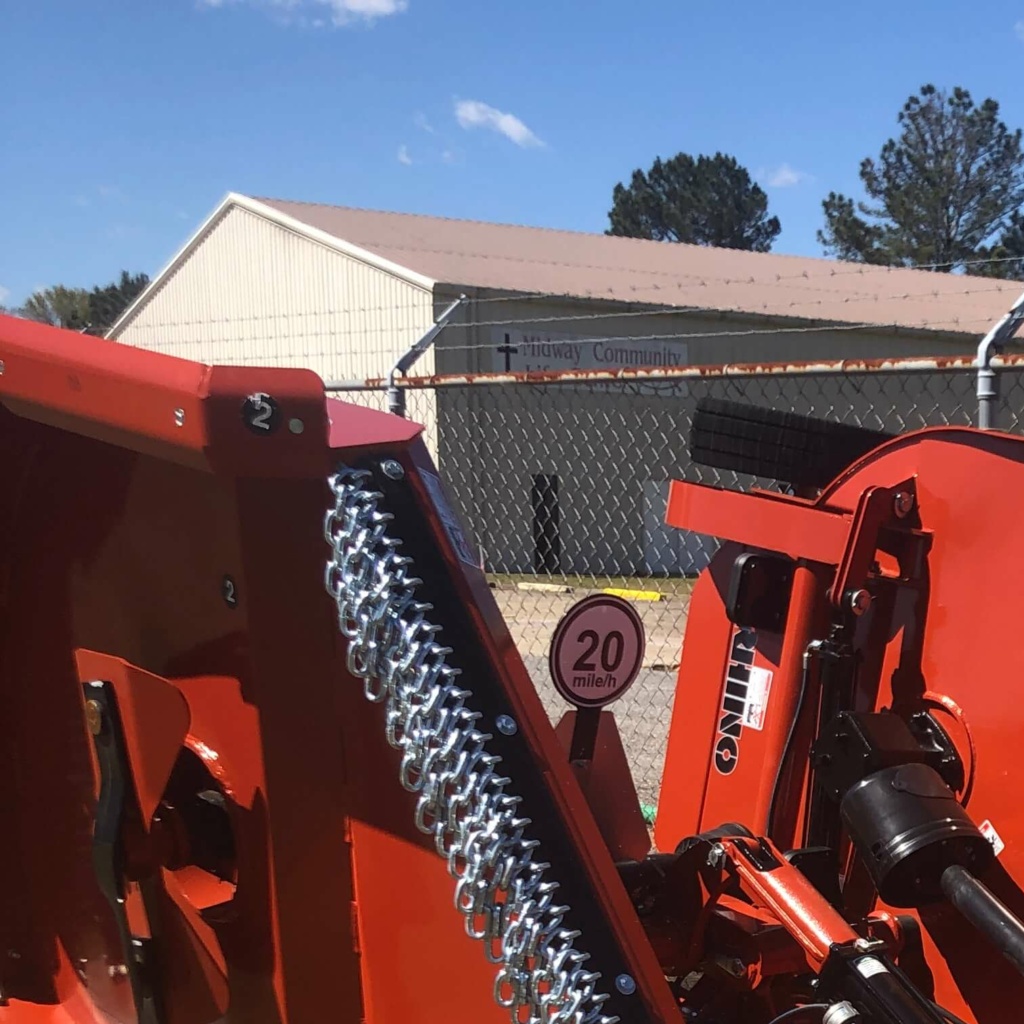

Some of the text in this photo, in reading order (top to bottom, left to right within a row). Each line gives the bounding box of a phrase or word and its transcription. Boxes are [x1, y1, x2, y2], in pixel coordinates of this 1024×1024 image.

[521, 334, 682, 368] Midway Community
[572, 629, 625, 672] 20
[571, 673, 618, 689] mile/h
[714, 627, 758, 776] RHINO
